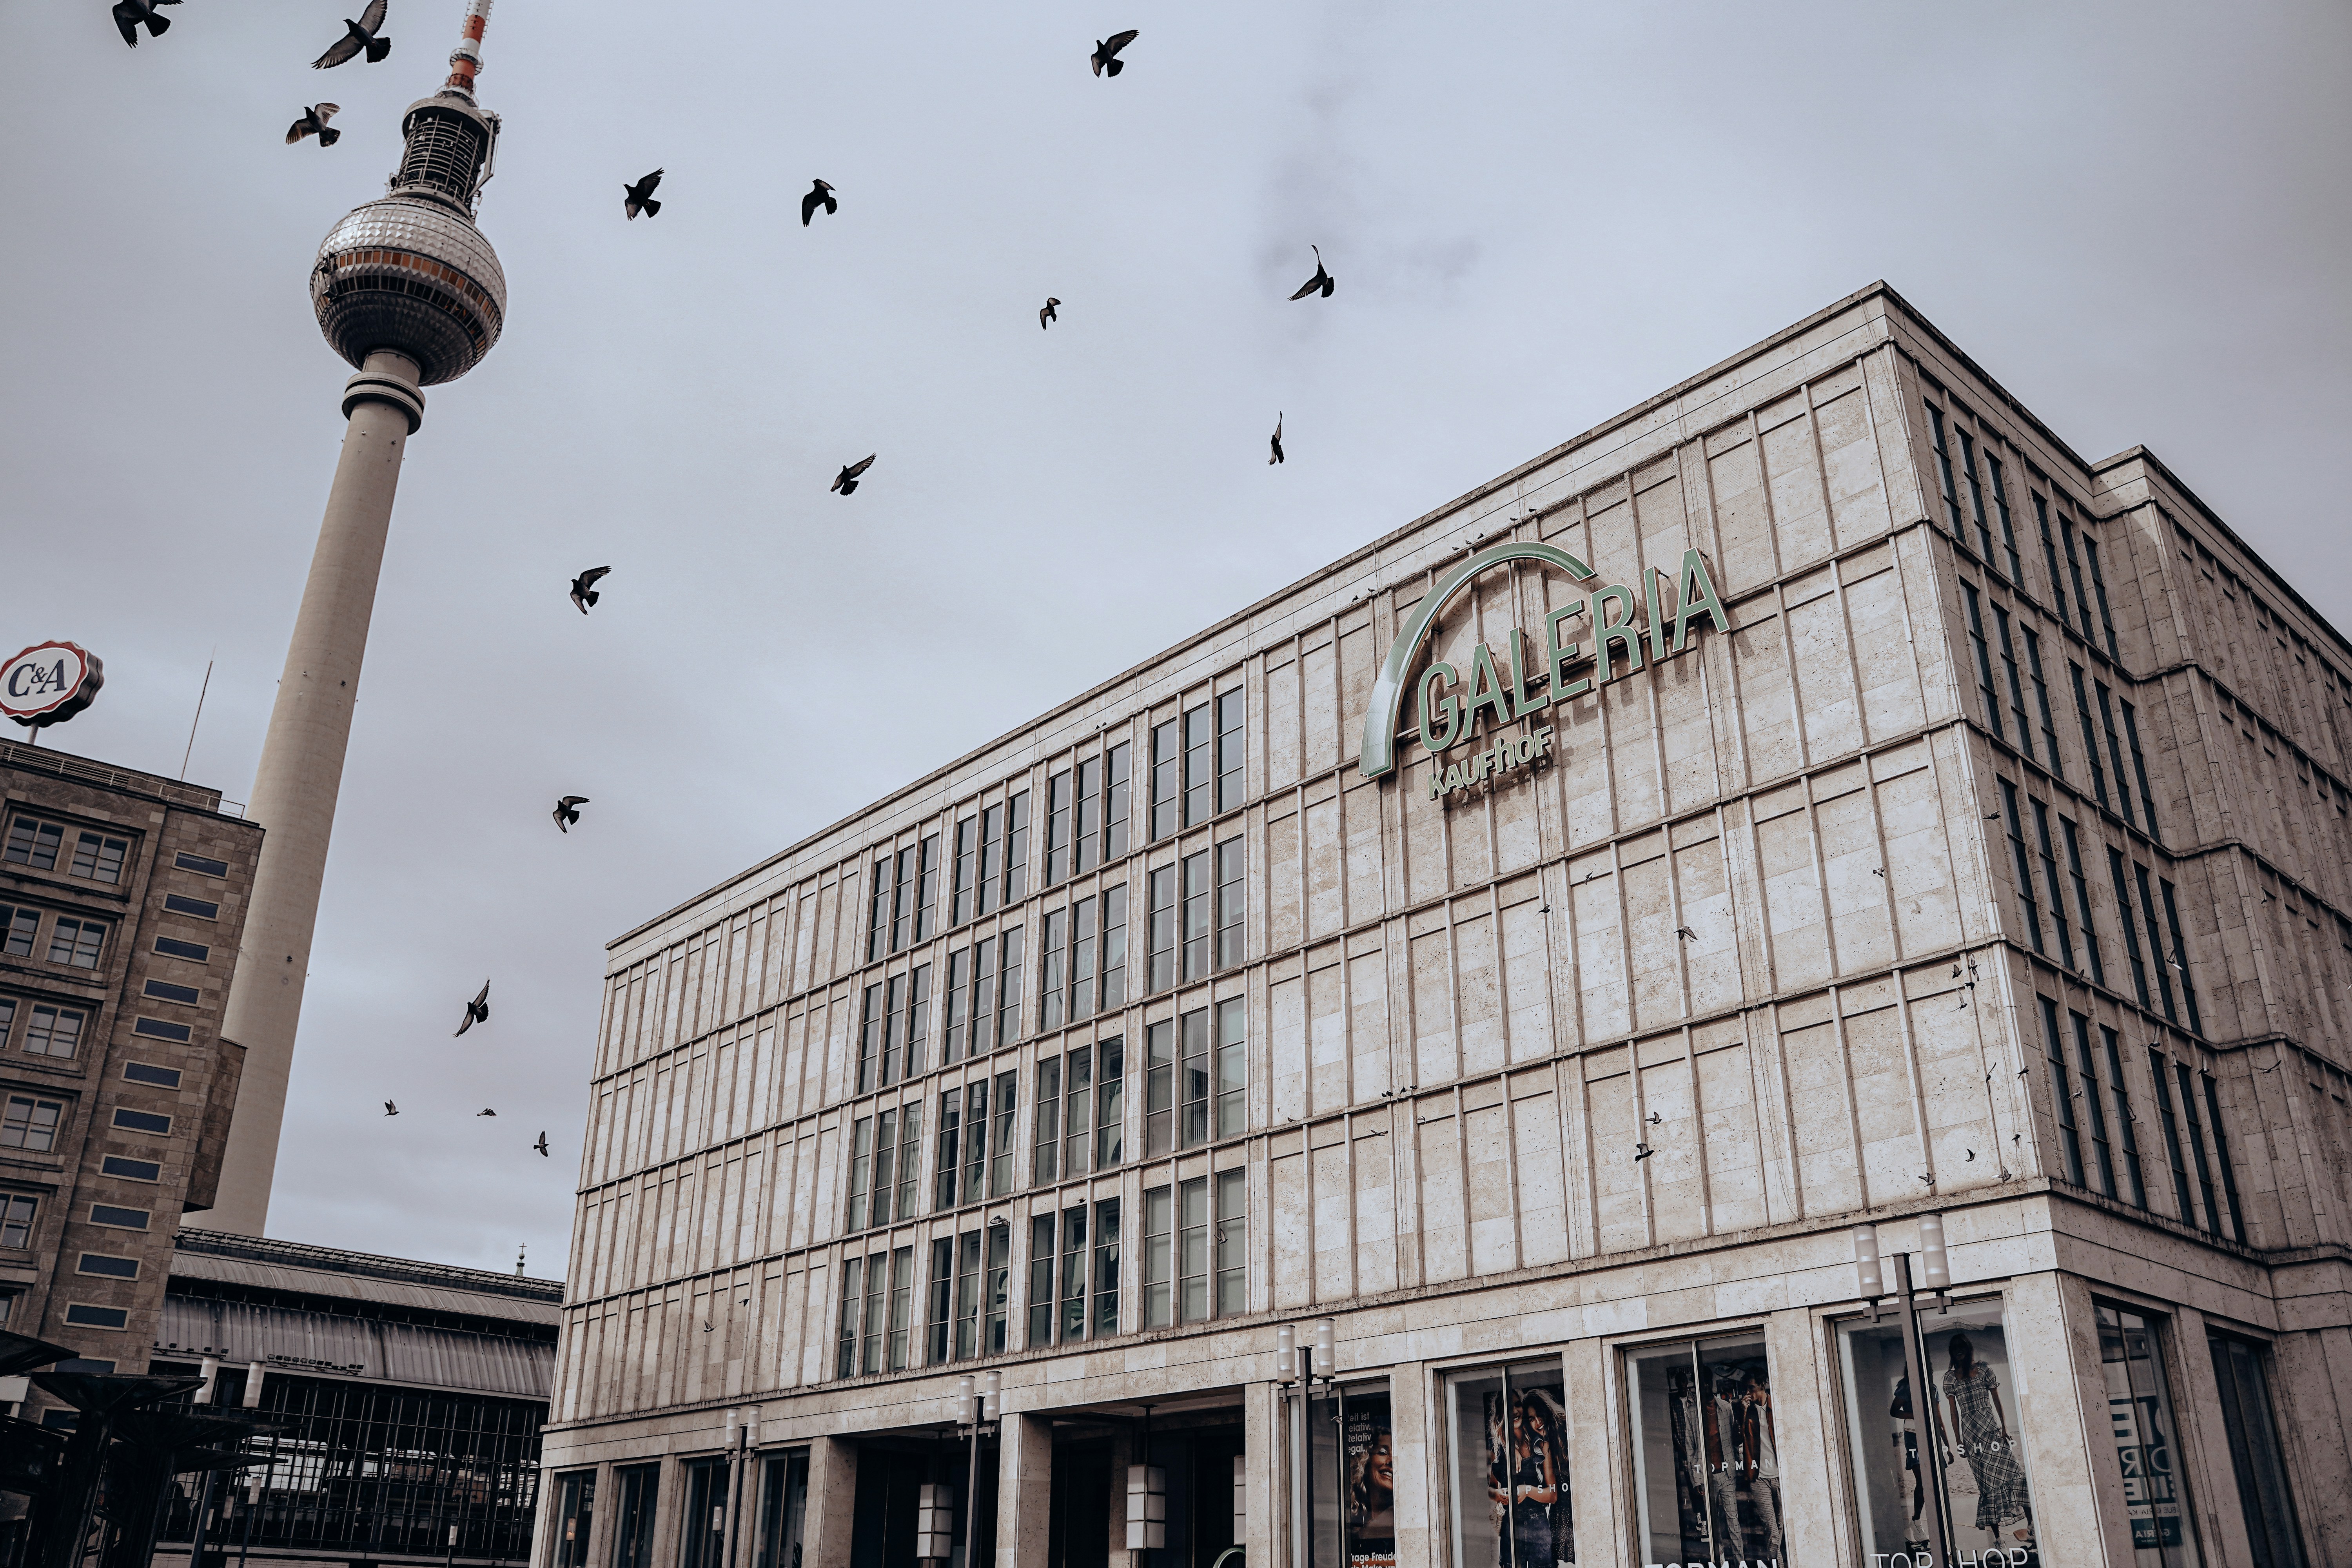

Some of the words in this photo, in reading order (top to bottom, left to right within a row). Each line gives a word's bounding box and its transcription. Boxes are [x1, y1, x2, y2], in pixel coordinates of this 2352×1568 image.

[1417, 546, 1731, 753] GALERIA
[8, 659, 67, 697] C&A
[1348, 1413, 1359, 1422] eit
[1361, 1412, 1370, 1421] ist
[1348, 1423, 1371, 1432] elativ.
[1909, 1440, 2018, 1459] TPSHOP
[1351, 1553, 1369, 1564] rage
[1869, 1547, 2029, 1568] TOPHOP
